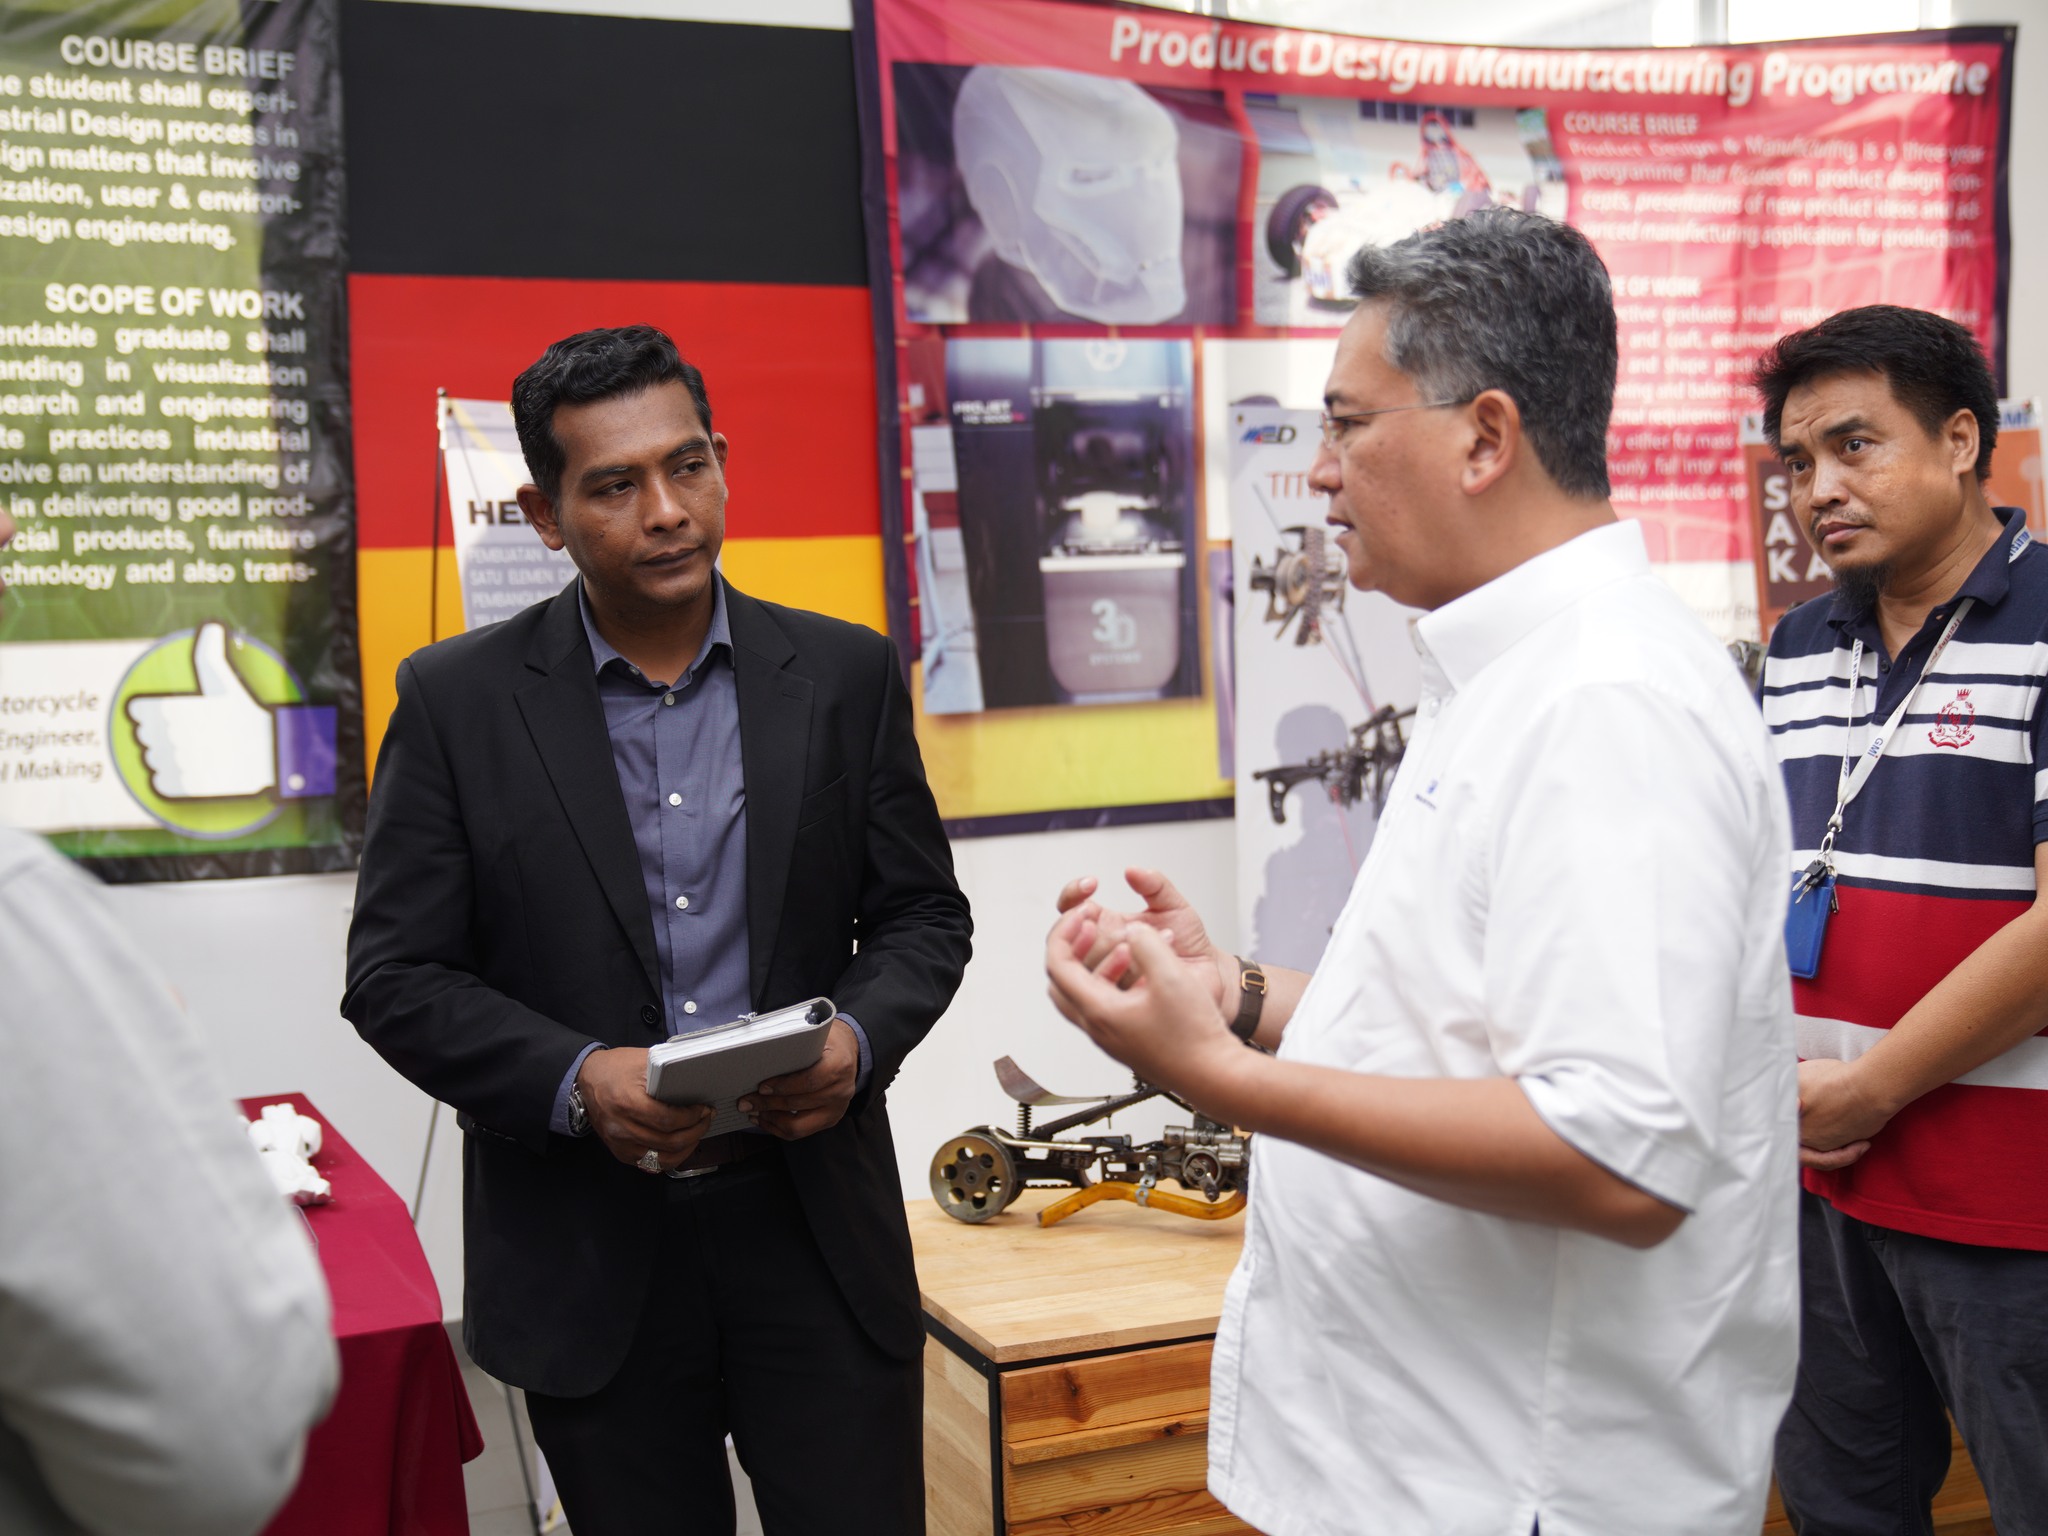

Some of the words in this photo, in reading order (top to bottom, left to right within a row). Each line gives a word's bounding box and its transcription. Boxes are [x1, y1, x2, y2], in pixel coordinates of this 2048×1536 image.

[60, 34, 199, 74] COURSE
[204, 45, 296, 79] BRIEF
[1109, 15, 1291, 75] Product
[1297, 33, 1447, 95] Design
[1453, 46, 1753, 107] Manufacturing
[1761, 52, 1989, 105] Programme
[0, 74, 22, 97] e
[30, 72, 133, 103] student
[139, 80, 203, 108] shall
[208, 87, 298, 116] experi-
[70, 108, 164, 145] Design
[167, 120, 269, 147] process
[274, 124, 299, 148] in
[1563, 111, 1641, 134] COURSE
[1644, 112, 1699, 136] BRIEF
[50, 145, 152, 174] matters
[155, 149, 208, 176] that
[210, 151, 301, 181] involve
[1862, 140, 1878, 161] is
[1580, 162, 1686, 185] programme
[1691, 161, 1726, 183] that
[1787, 167, 1811, 187] on
[1816, 168, 1884, 191] product
[1887, 169, 1944, 196] design
[101, 184, 162, 208] user
[169, 183, 191, 210] &
[197, 187, 302, 213] environ-
[1744, 190, 1765, 214] of
[1765, 196, 1803, 216] new
[1804, 193, 1873, 220] product
[1920, 197, 1954, 219] and
[75, 215, 237, 251] engineering.
[1640, 219, 1760, 248] manufacturing
[1761, 222, 1852, 248] application
[1856, 222, 1880, 246] for
[1627, 275, 1650, 296] OF
[1651, 275, 1700, 297] WORK
[45, 283, 156, 315] SCOPE
[160, 287, 204, 317] OF
[208, 288, 305, 320] WORK
[1662, 305, 1736, 327] graduates
[1741, 304, 1775, 324] shall
[115, 324, 231, 354] graduate
[246, 328, 306, 353] shall
[1628, 329, 1660, 349] and
[106, 356, 131, 382] in
[152, 357, 307, 386] visualization
[1628, 355, 1659, 374] and
[0, 390, 79, 416] earch
[95, 390, 145, 416] and
[159, 392, 308, 424] engineering
[49, 424, 171, 455] practices
[194, 425, 311, 452] industrial
[1673, 429, 1693, 449] for
[57, 462, 92, 484] an
[98, 458, 280, 489] understanding
[284, 460, 311, 484] of
[10, 492, 36, 518] in
[42, 491, 171, 522] delivering
[177, 492, 241, 522] good
[247, 492, 314, 521] prod-
[469, 500, 531, 525] HE
[5, 526, 59, 552] cial
[73, 525, 195, 555] products,
[207, 524, 317, 551] furniture
[125, 559, 175, 584] and
[183, 558, 235, 583] also
[243, 558, 317, 583] trans-
[1938, 618, 1961, 651] Training
[15, 758, 104, 784] Making
